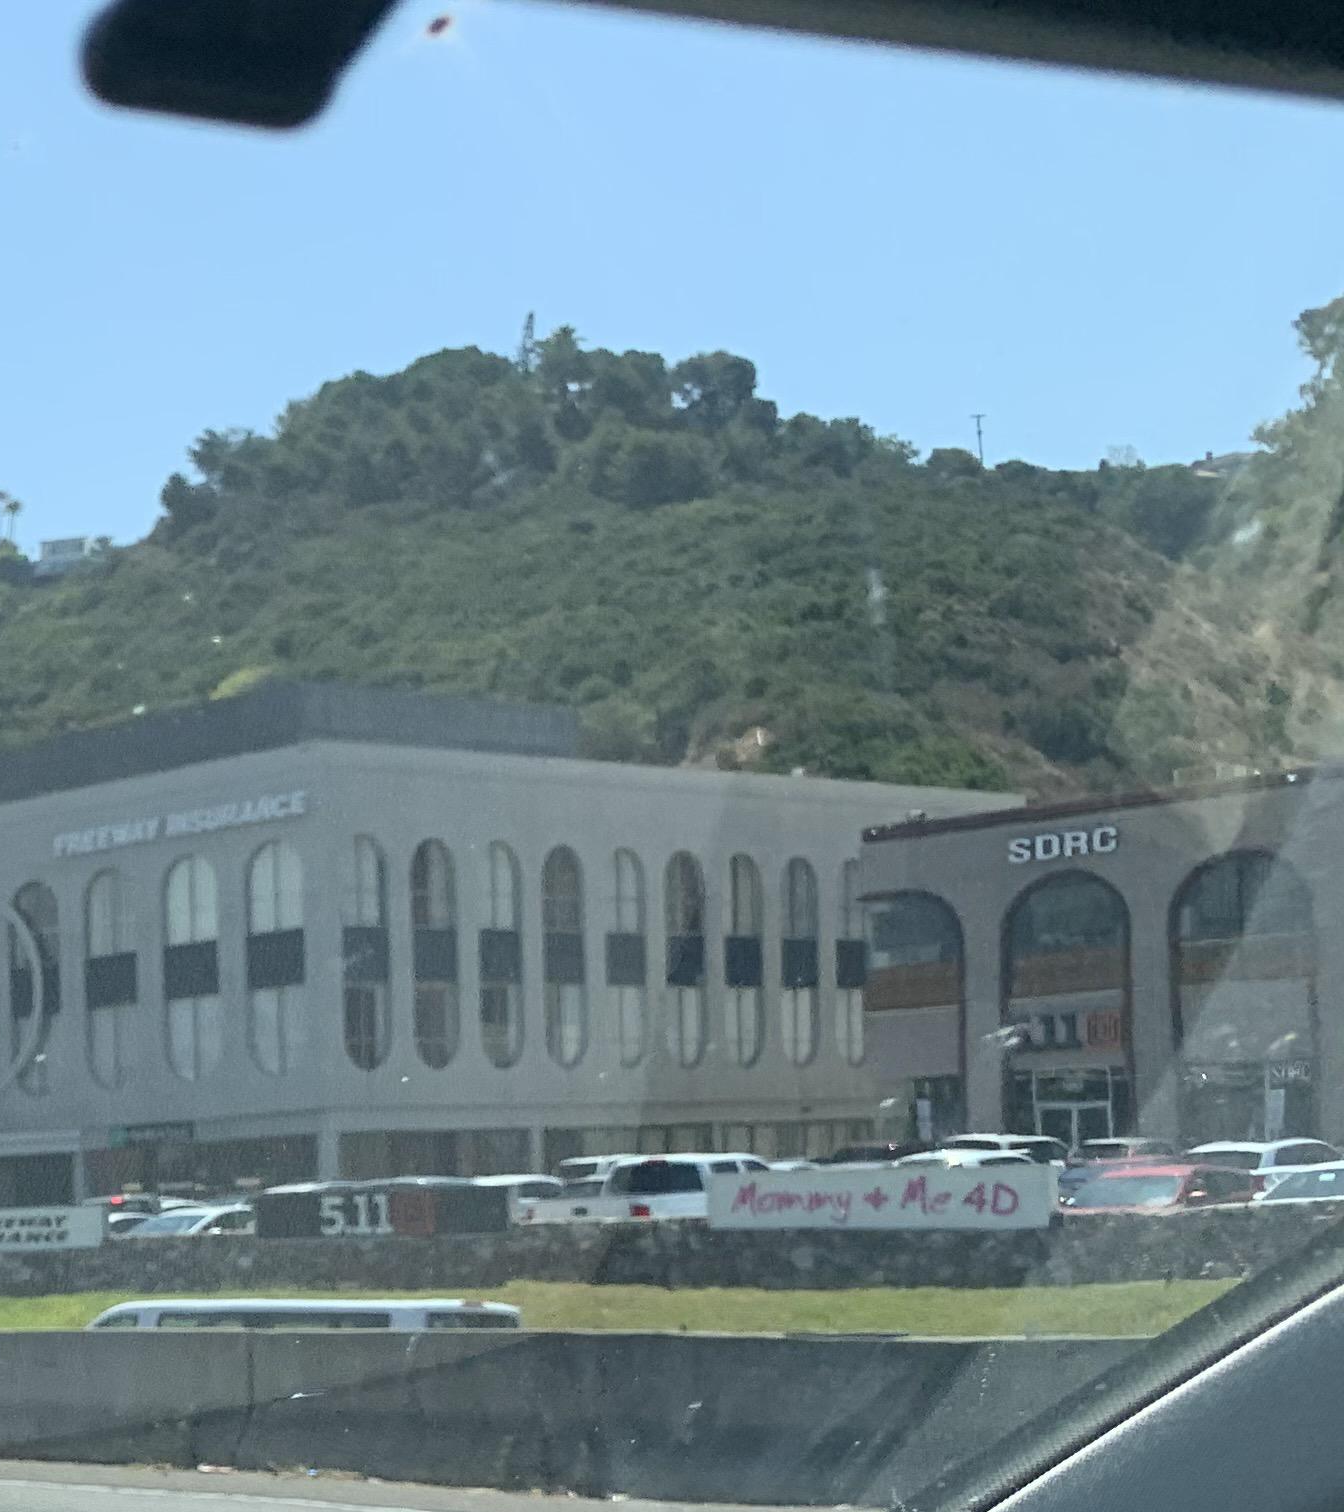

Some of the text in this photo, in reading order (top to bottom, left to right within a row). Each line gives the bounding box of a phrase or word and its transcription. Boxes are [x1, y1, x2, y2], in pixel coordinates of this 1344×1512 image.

[1008, 826, 1117, 864] SDRC
[319, 1193, 395, 1236] 5.11
[731, 1181, 852, 1224] Mommy
[901, 1174, 953, 1214] Me
[964, 1180, 1020, 1216] 4D
